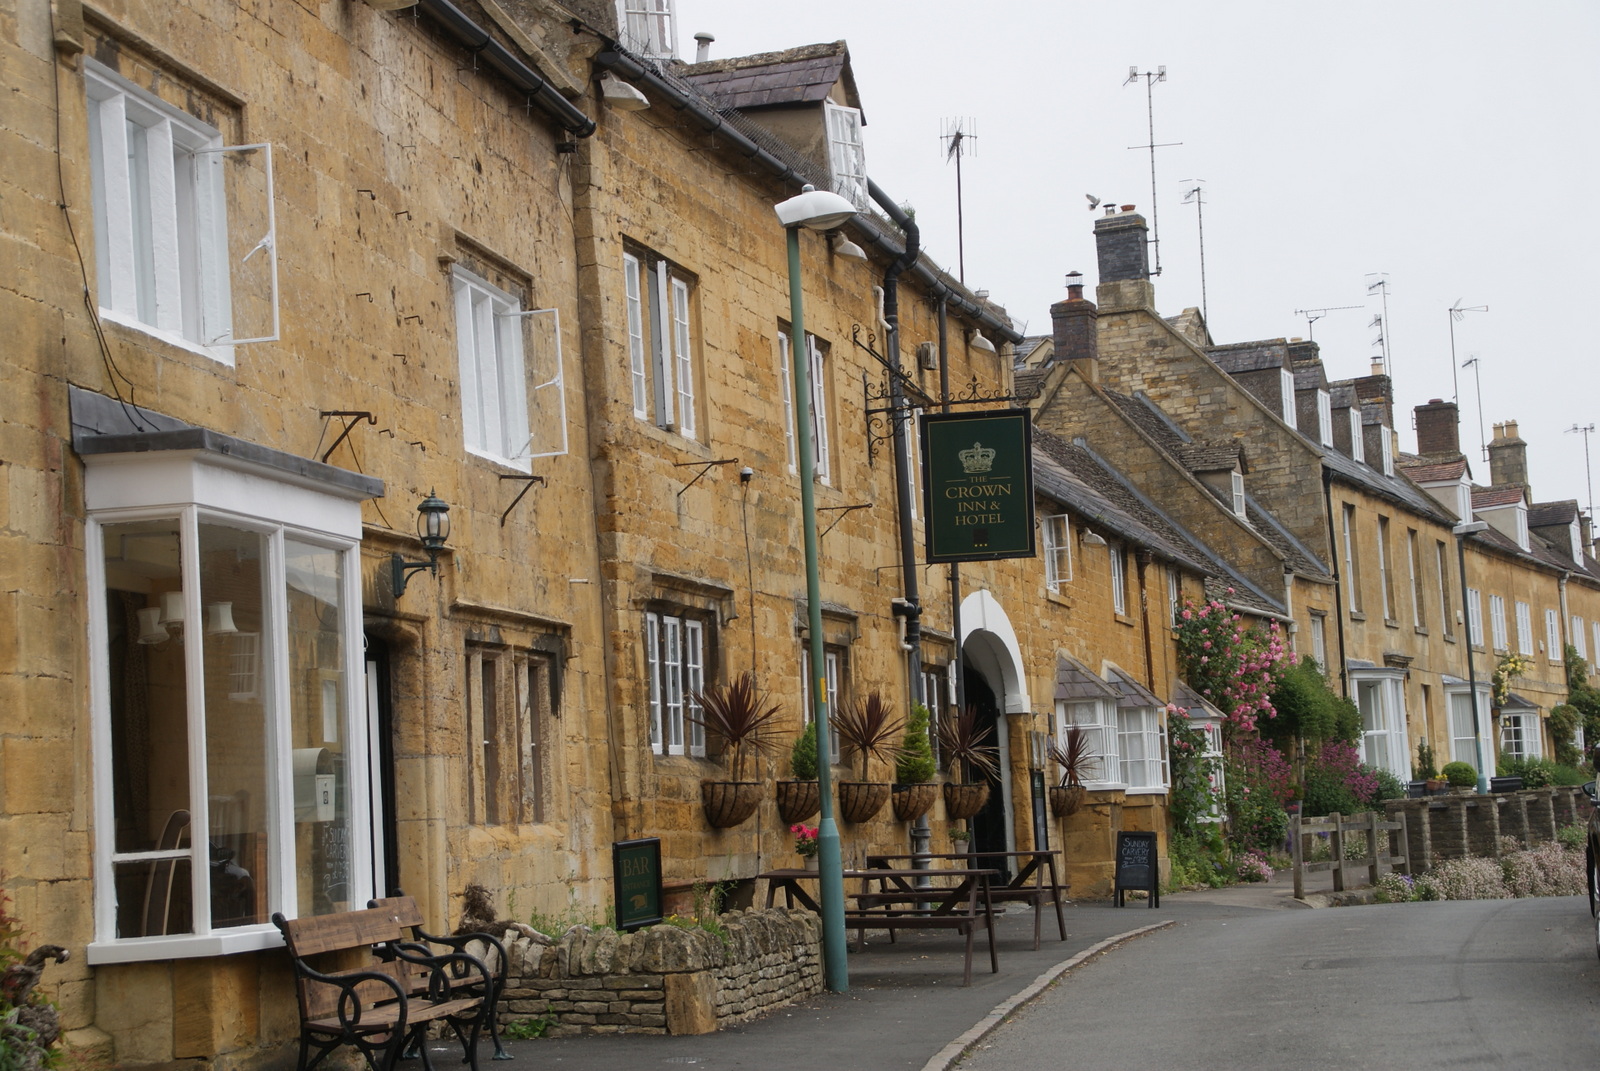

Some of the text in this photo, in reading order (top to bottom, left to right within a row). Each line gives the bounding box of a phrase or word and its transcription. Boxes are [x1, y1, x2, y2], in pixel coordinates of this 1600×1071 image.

[968, 475, 988, 483] THE
[945, 483, 1012, 499] CROWN
[957, 501, 1001, 512] INN &
[955, 513, 1005, 526] HOTEL
[1122, 837, 1150, 848] SUNDAY
[1121, 847, 1150, 856] CARVERY
[623, 856, 650, 877] BAR
